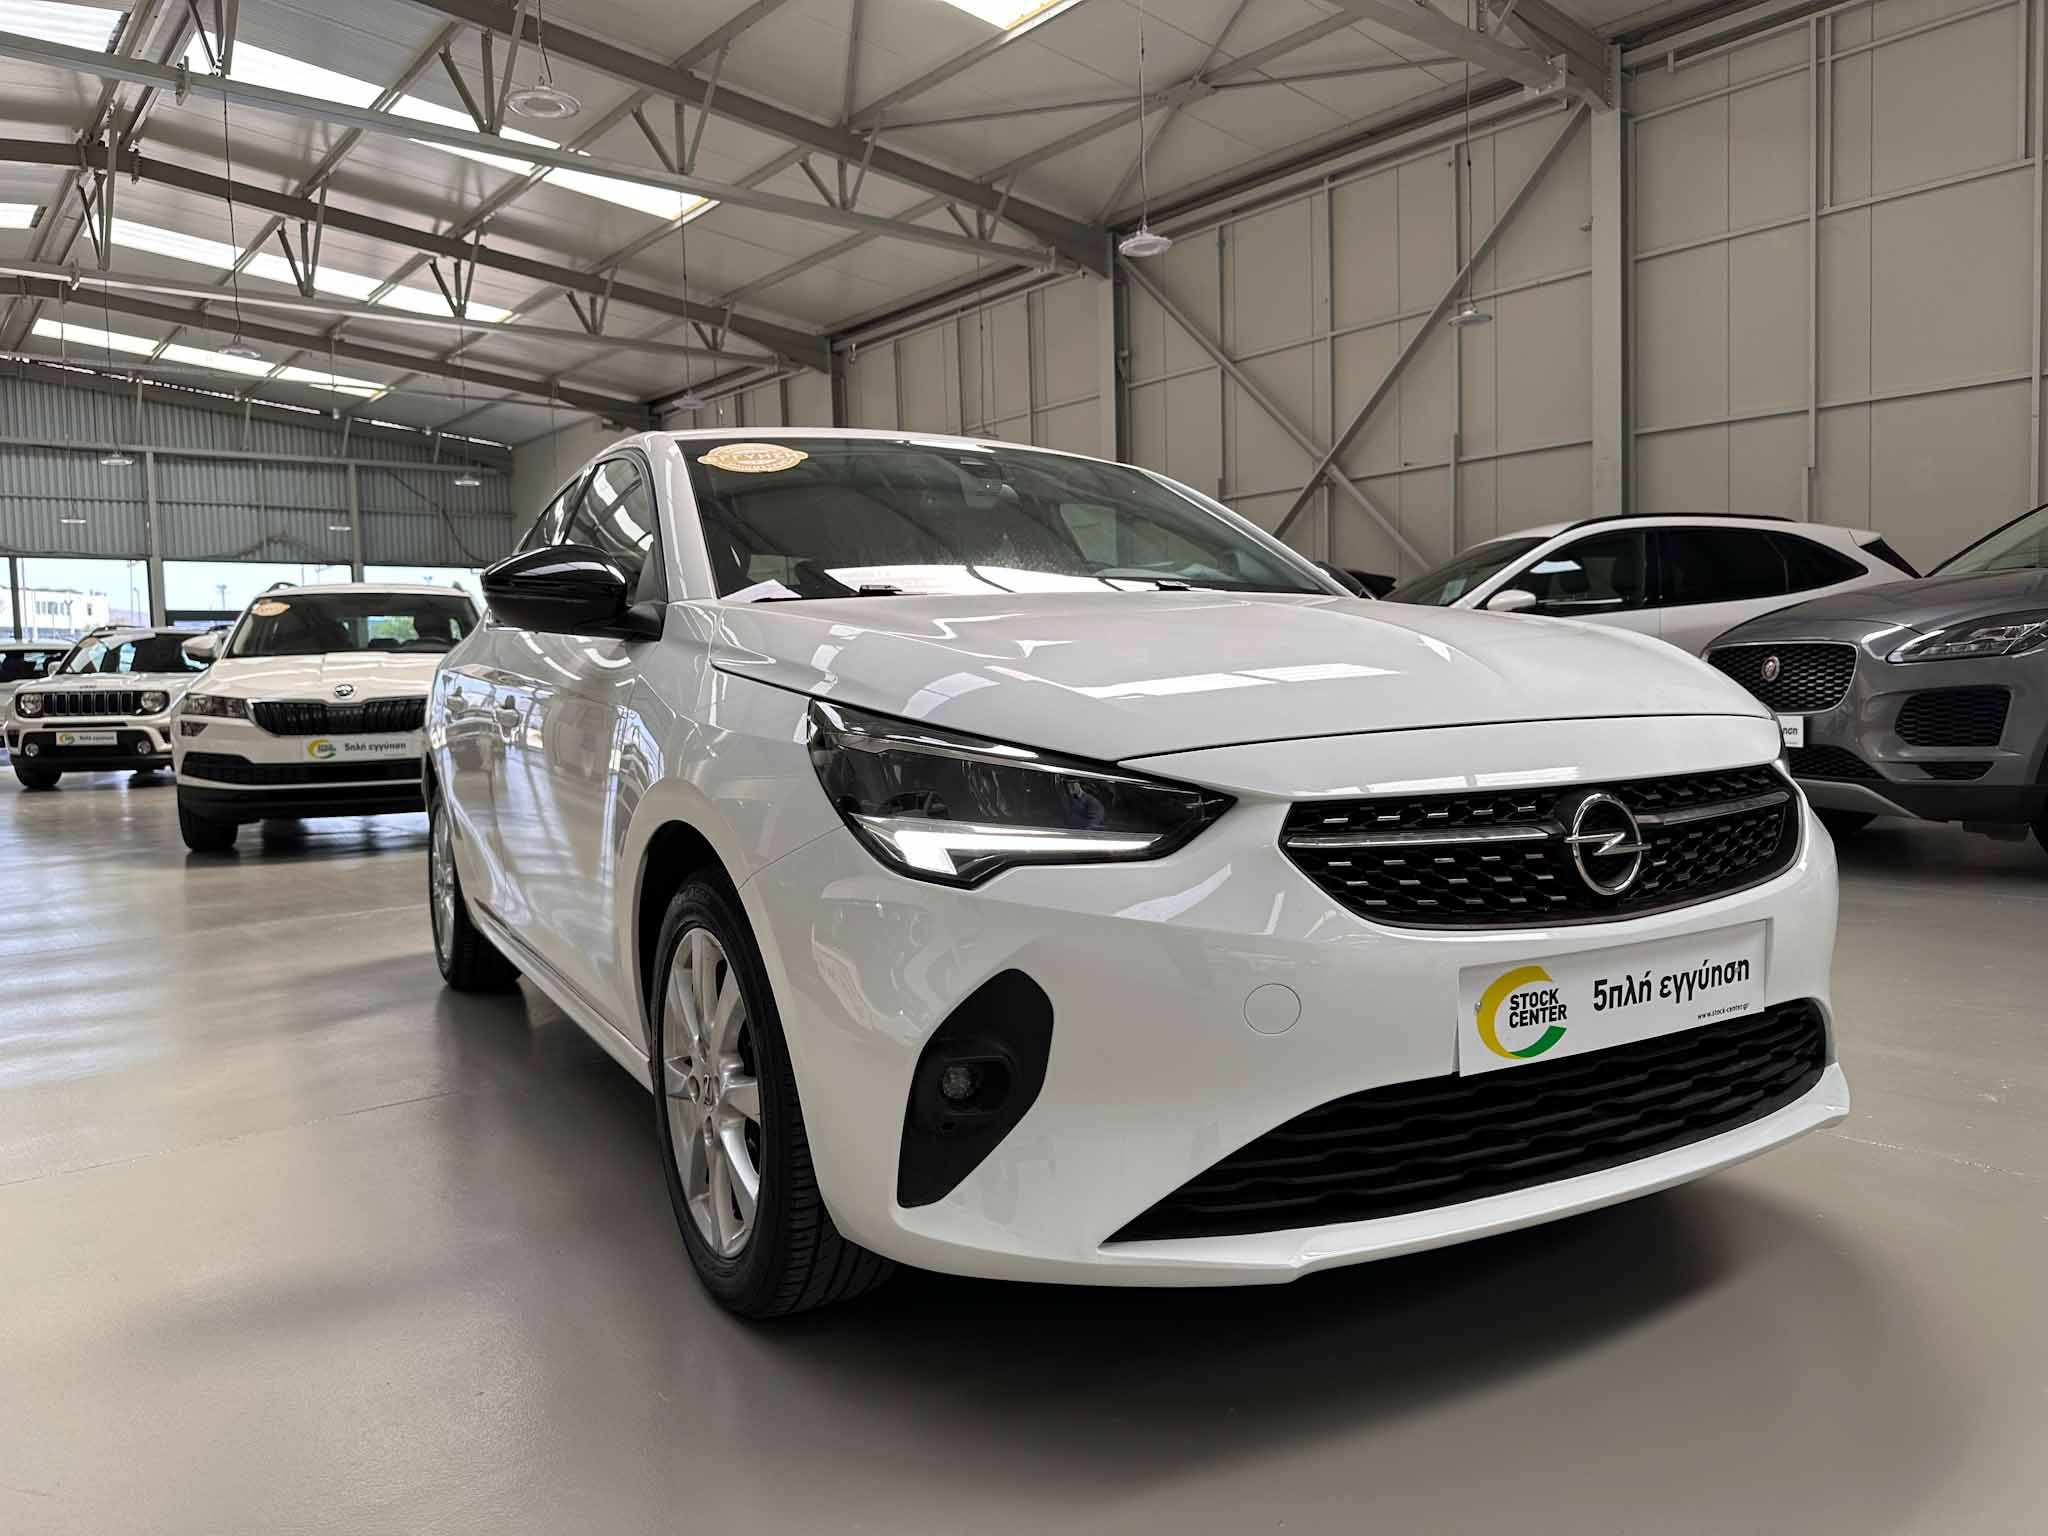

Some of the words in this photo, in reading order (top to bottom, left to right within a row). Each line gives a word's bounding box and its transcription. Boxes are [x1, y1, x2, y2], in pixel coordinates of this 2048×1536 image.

[1593, 970, 1652, 1011] 5πλή
[1659, 959, 1750, 1003] εγγύηση
[1509, 988, 1560, 1012] STOCK
[1509, 1004, 1567, 1028] CENTER
